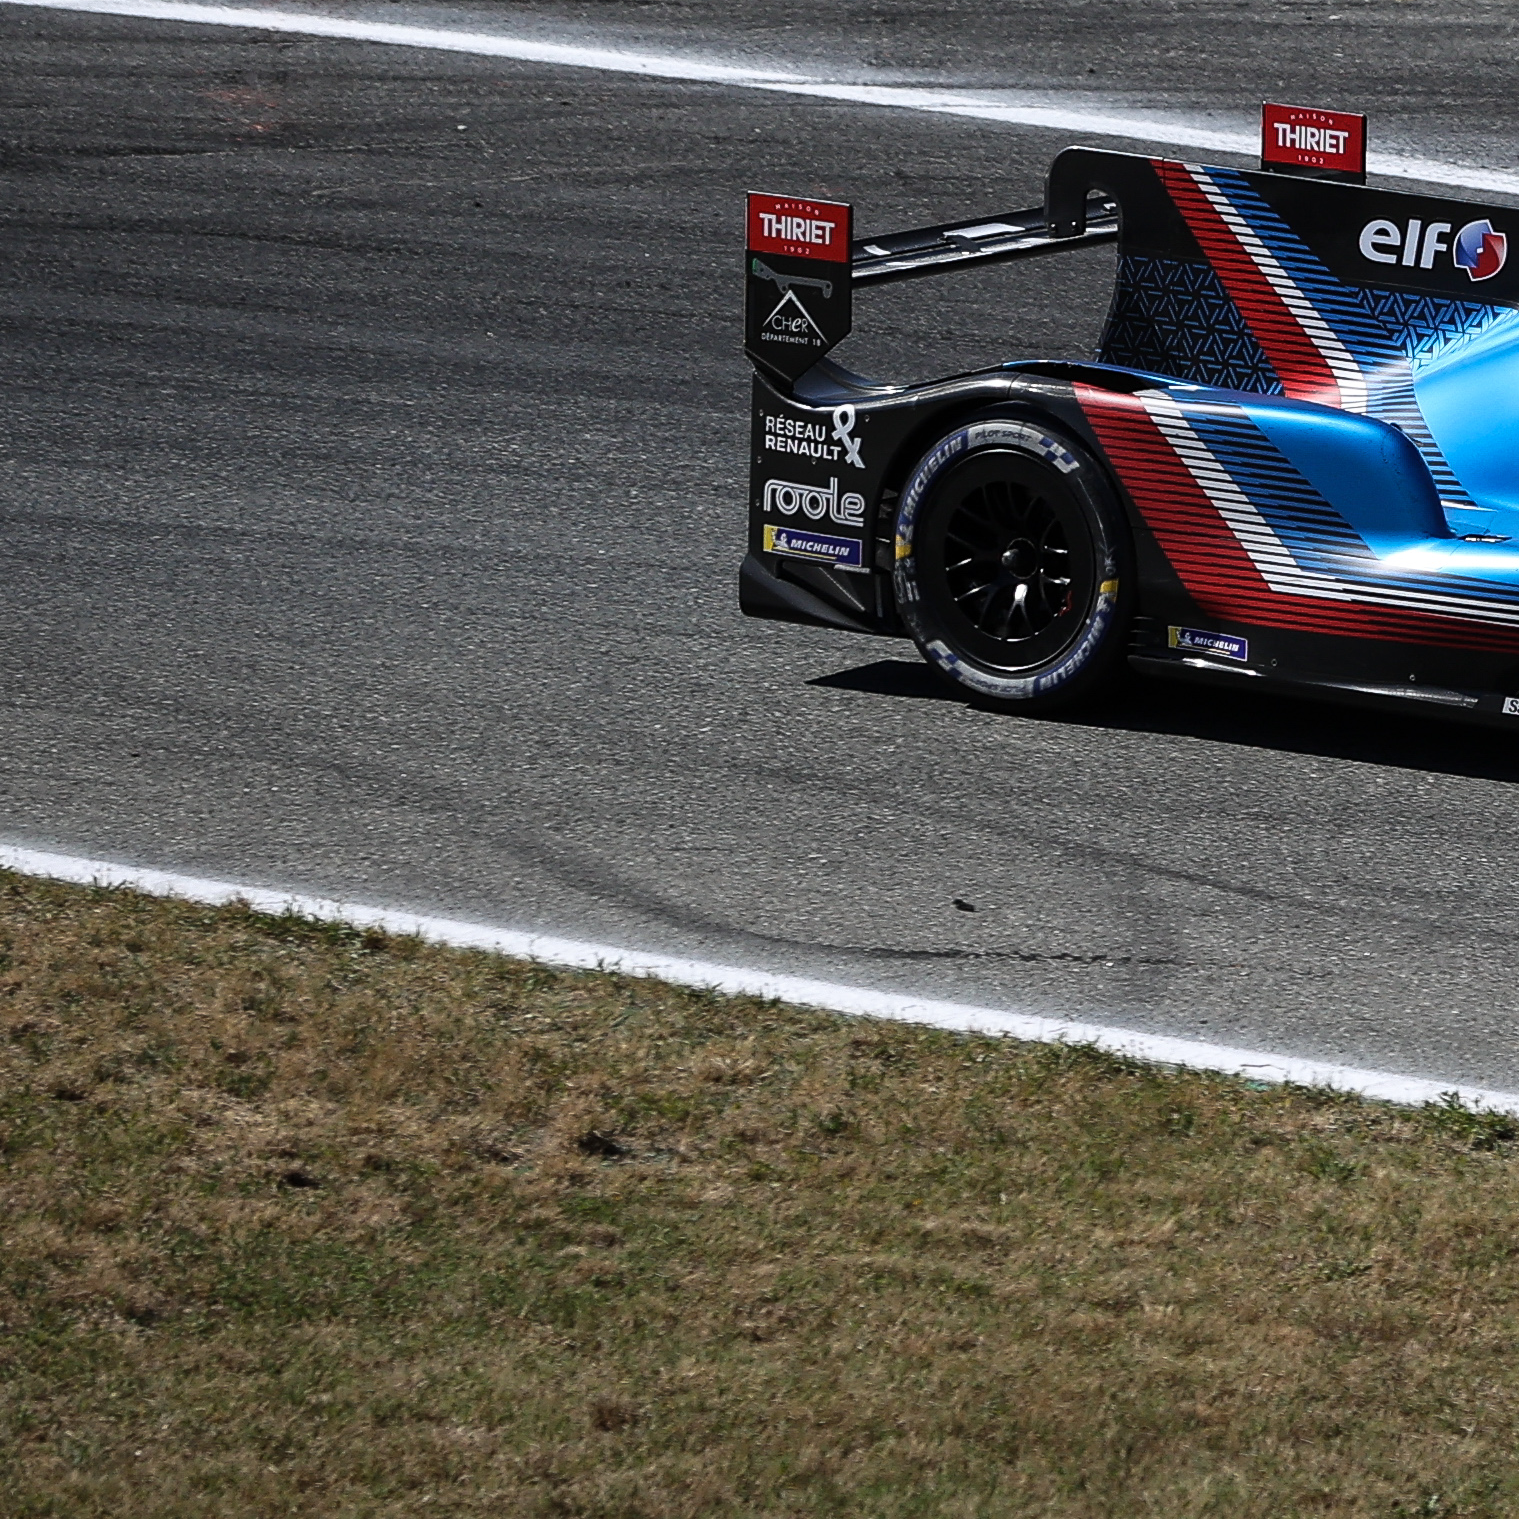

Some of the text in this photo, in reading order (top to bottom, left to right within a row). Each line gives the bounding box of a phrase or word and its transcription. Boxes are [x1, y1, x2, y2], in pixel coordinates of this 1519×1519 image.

[1273, 122, 1349, 155] THIRIET
[759, 212, 836, 245] THIRIET
[1359, 218, 1452, 270] elf
[765, 414, 826, 442] RÉSEAU
[765, 435, 841, 461] RENAULT
[903, 435, 963, 519] MICHELIN
[764, 477, 865, 527] roole
[790, 539, 849, 556] MICHELIN
[1040, 616, 1104, 690] MICHELIN
[1193, 635, 1239, 653] MICHELIN
